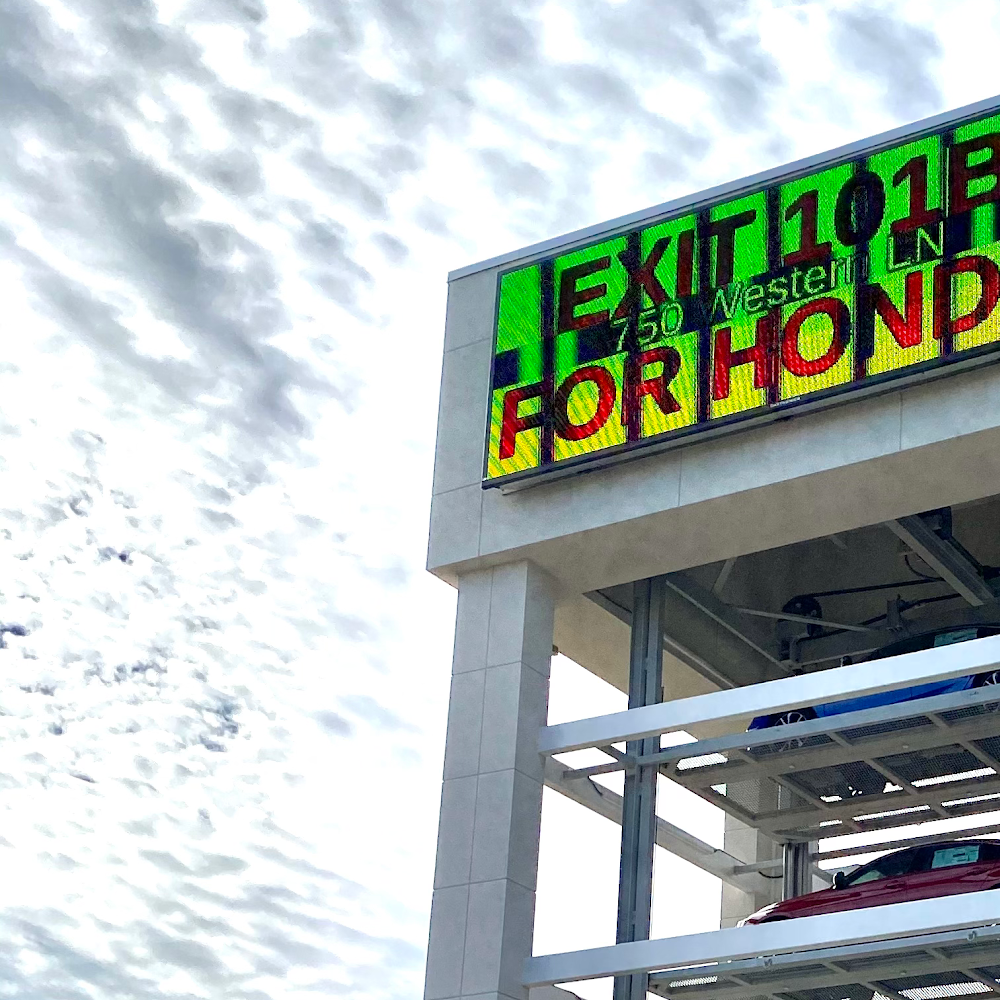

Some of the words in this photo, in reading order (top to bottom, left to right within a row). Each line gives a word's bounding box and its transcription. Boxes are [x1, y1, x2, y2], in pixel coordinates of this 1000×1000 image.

[557, 208, 757, 333] EXIT
[612, 300, 684, 352] 750
[887, 220, 945, 272] LN
[499, 345, 682, 461] FOR
